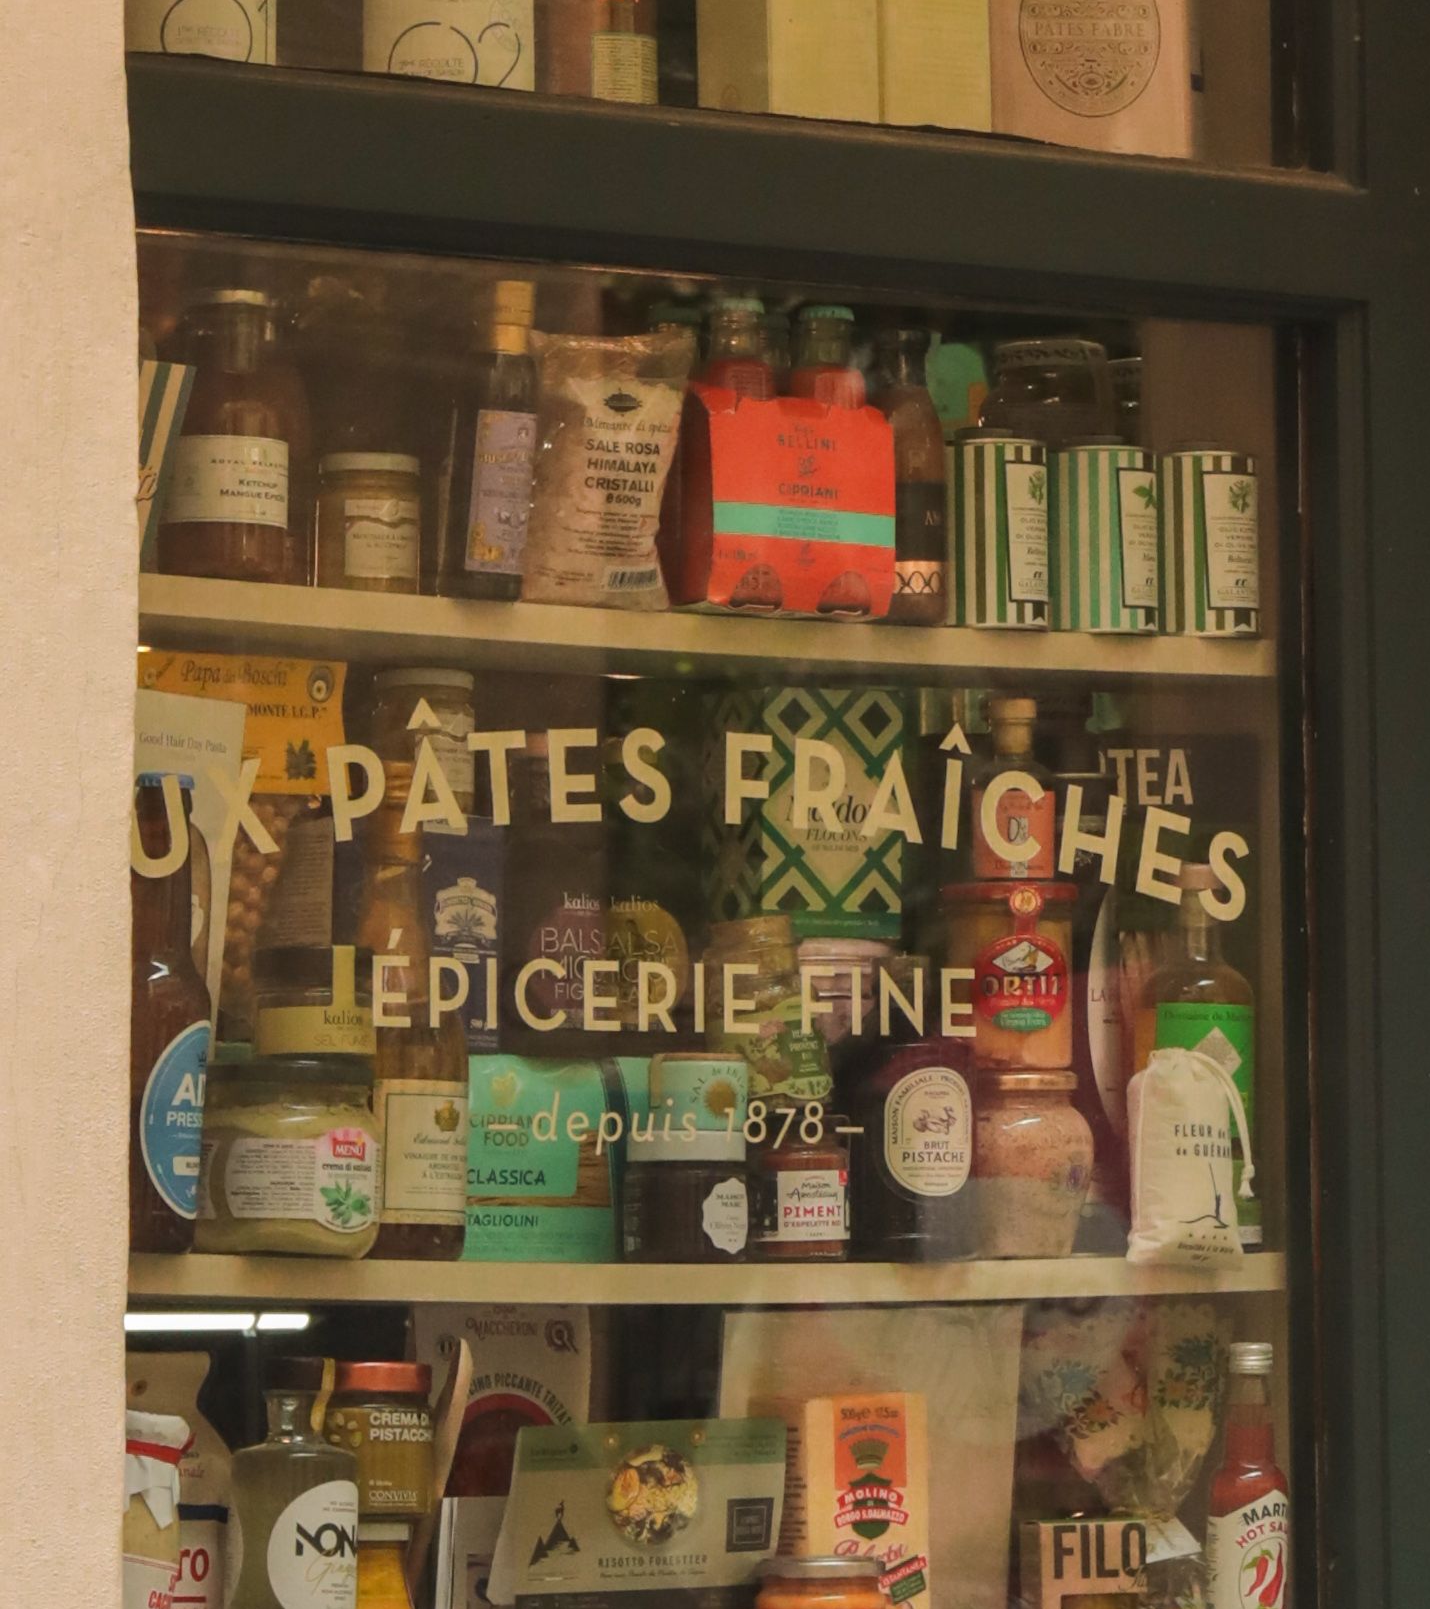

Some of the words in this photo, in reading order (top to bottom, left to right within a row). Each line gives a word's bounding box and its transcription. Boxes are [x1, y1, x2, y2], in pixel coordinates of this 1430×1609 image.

[585, 438, 620, 454] SALE
[625, 442, 660, 456] ROSA
[776, 433, 837, 452] BELLINI
[587, 458, 657, 474] HIMALAYA
[584, 476, 654, 493] CRISTALLI
[181, 659, 221, 690] Papa
[248, 703, 288, 718] MONTE
[166, 733, 185, 749] Hair
[326, 698, 671, 842] PÂTES
[724, 723, 1249, 920] FRAÎCHES
[372, 928, 759, 1034] ÉPICERIE
[801, 963, 976, 1037] FINE
[531, 1091, 697, 1156] depuis
[724, 1100, 824, 1150] 1878
[1174, 1124, 1213, 1138] FLEUR
[483, 1131, 529, 1147] FOOD
[924, 1141, 950, 1150] BRUT
[901, 1151, 965, 1164] PISTACHE
[467, 1168, 546, 1186] CLASSICA
[783, 1205, 842, 1219] PIMENT
[467, 1213, 539, 1228] TAGLIOLINI
[369, 1413, 420, 1428] CREMA
[844, 1486, 898, 1505] MOLINO
[1235, 1523, 1265, 1549] HOT
[1052, 1521, 1146, 1581] FILO
[598, 1555, 645, 1568] RISOTTO
